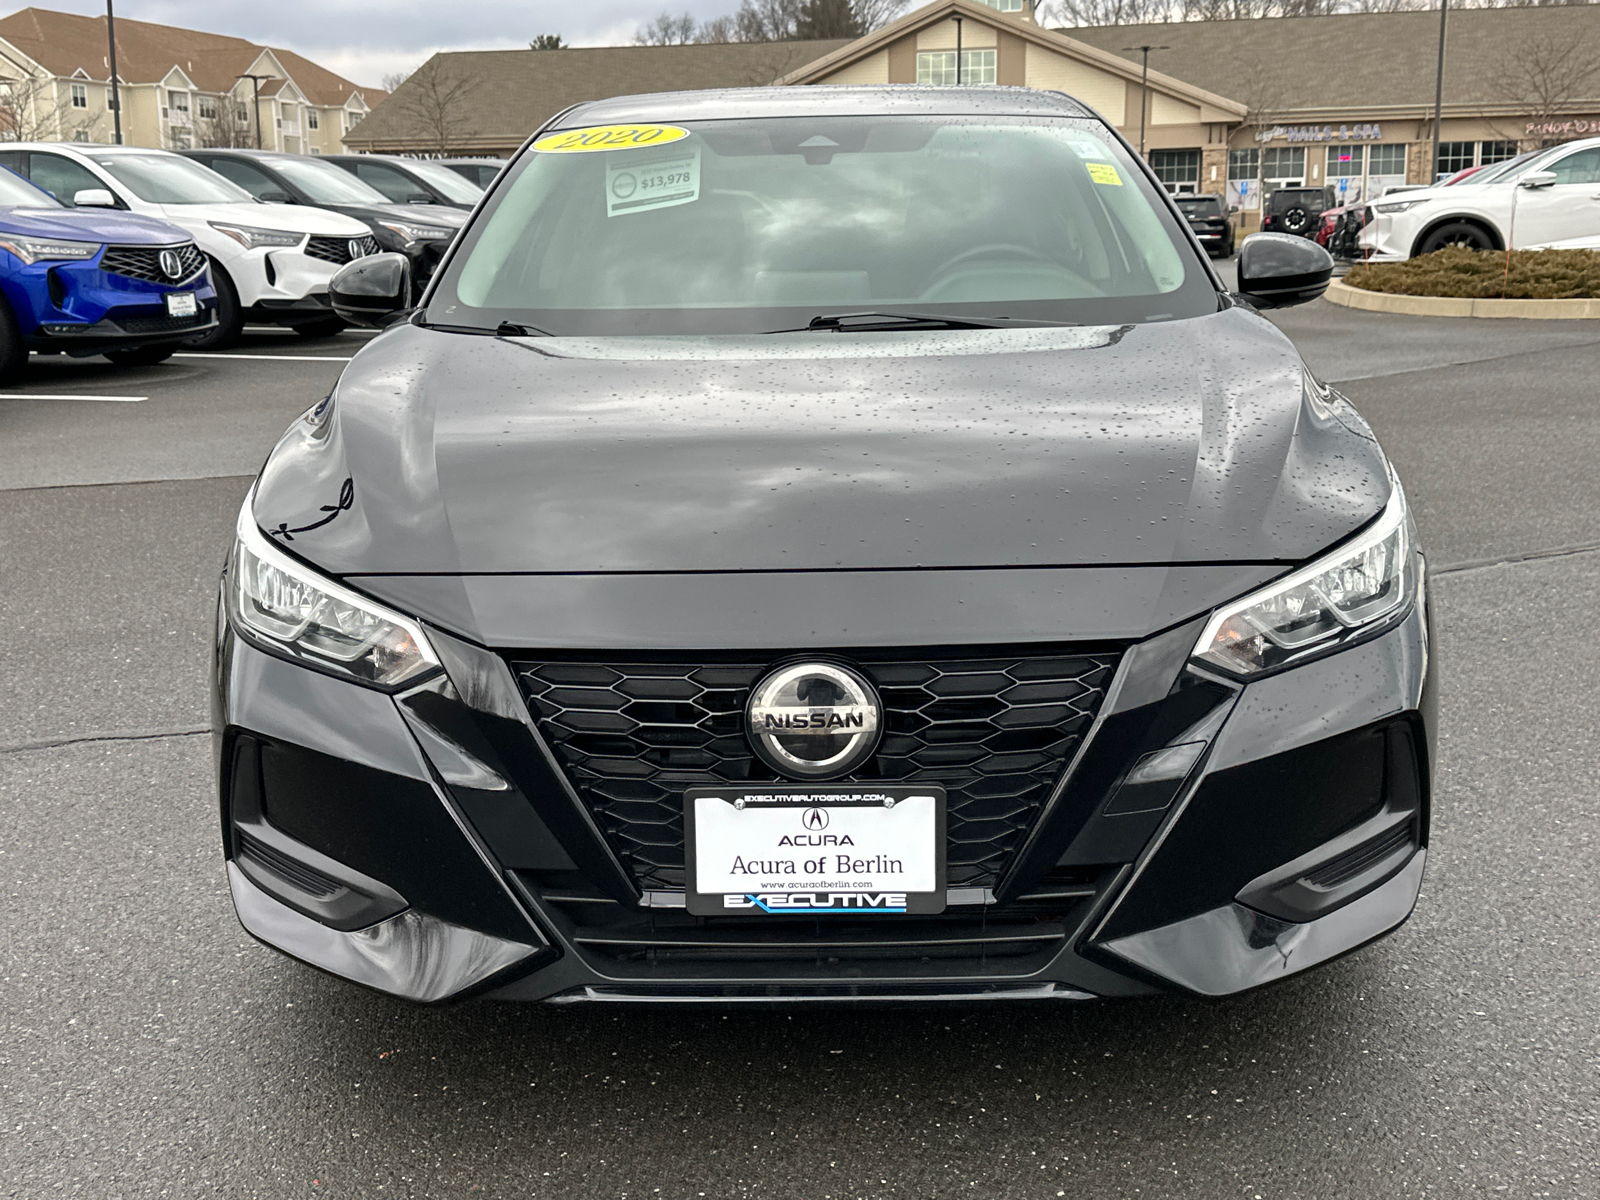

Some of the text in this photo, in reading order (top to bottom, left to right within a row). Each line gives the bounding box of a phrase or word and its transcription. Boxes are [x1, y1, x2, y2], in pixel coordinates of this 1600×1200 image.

[552, 128, 664, 150] 2020
[1287, 125, 1332, 141] NAILS
[1339, 124, 1349, 140] &
[1353, 124, 1382, 139] SPA
[641, 171, 690, 190] $13,978
[765, 712, 863, 729] NISSAN
[744, 794, 885, 802] EXECUTIVEAUTOGROUP.COM
[778, 834, 855, 847] ACURA
[729, 854, 904, 875] Acura of Berlin
[760, 880, 873, 889] www.acuraofberlin.com
[723, 893, 907, 908] EXECUTIVE
